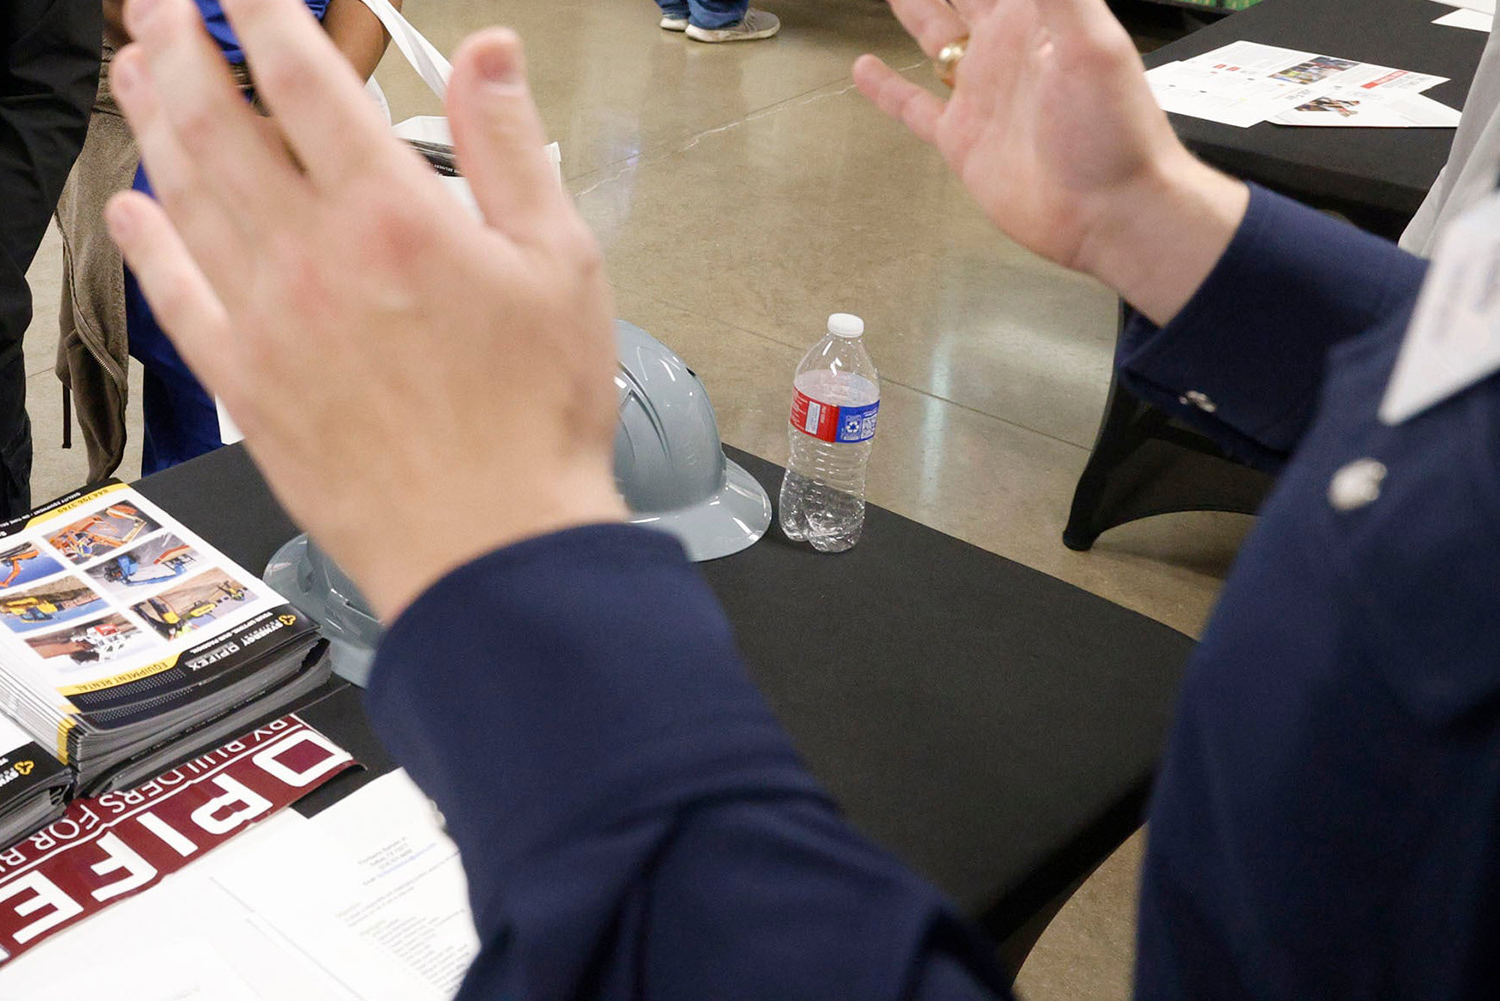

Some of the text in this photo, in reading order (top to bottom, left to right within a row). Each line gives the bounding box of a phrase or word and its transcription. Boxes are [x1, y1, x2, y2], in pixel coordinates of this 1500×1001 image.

[191, 619, 284, 672] SYNERGY OPIFEX
[75, 662, 169, 692] EQUIPMENT RENTAL
